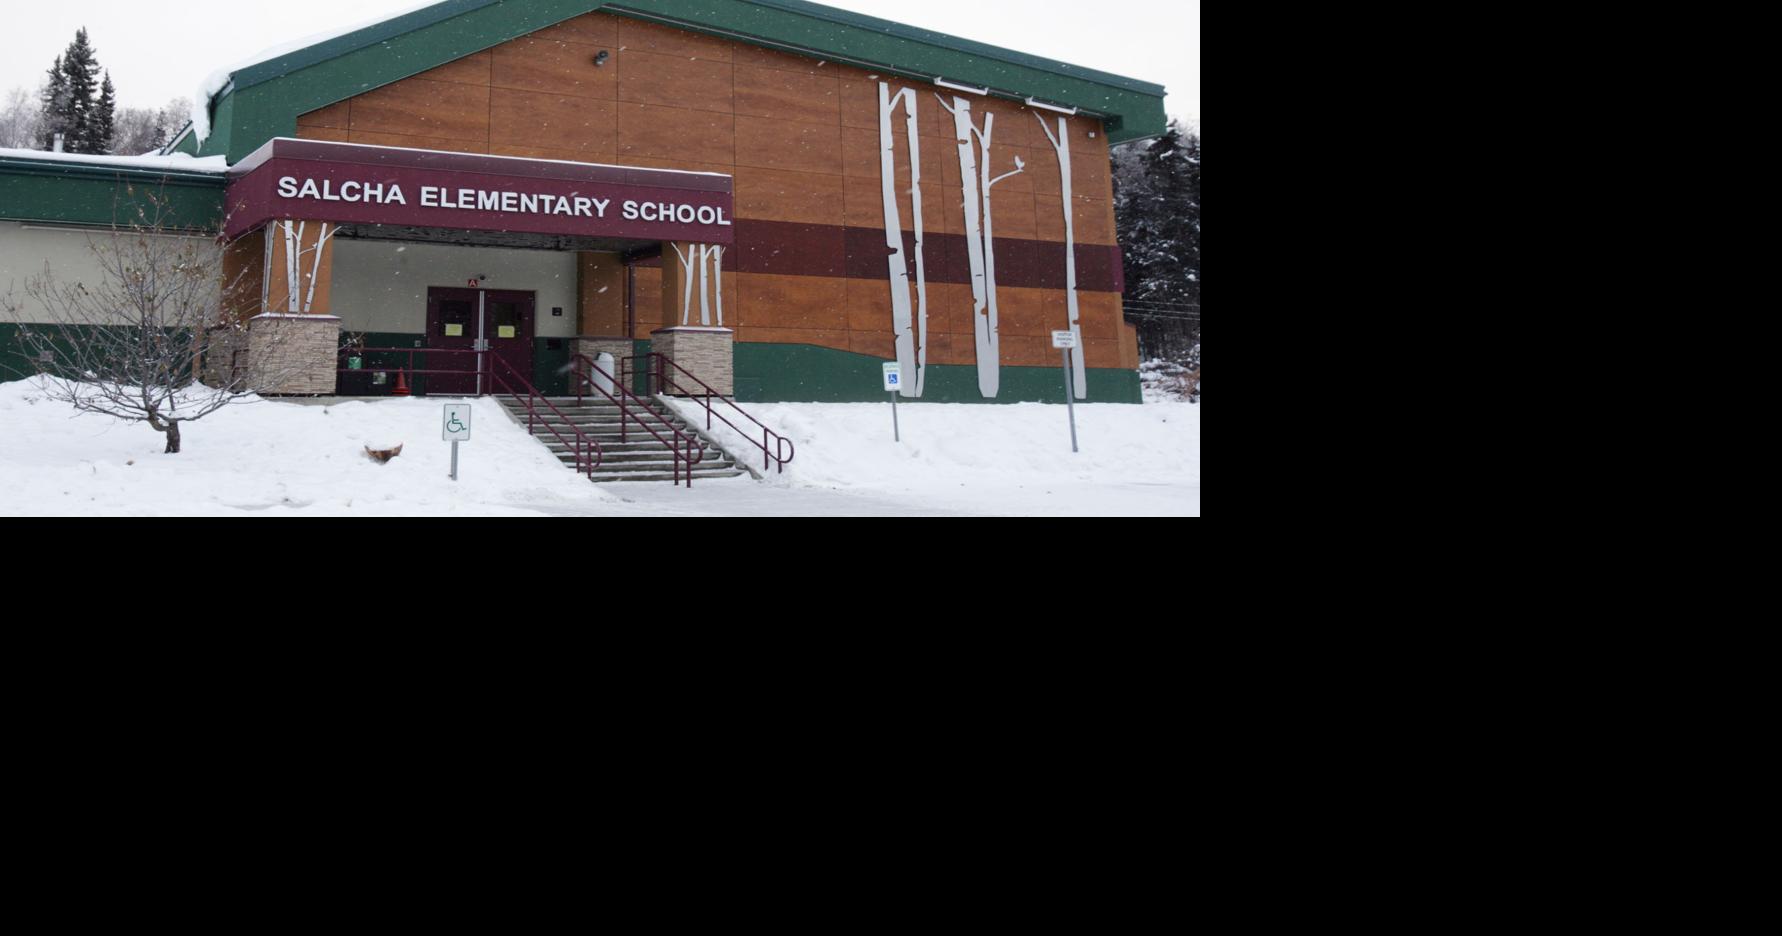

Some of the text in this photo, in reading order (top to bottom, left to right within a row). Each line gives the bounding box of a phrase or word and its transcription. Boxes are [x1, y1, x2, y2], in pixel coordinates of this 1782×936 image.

[277, 176, 731, 225] SALCHA ELEMENTARY SCHOOL
